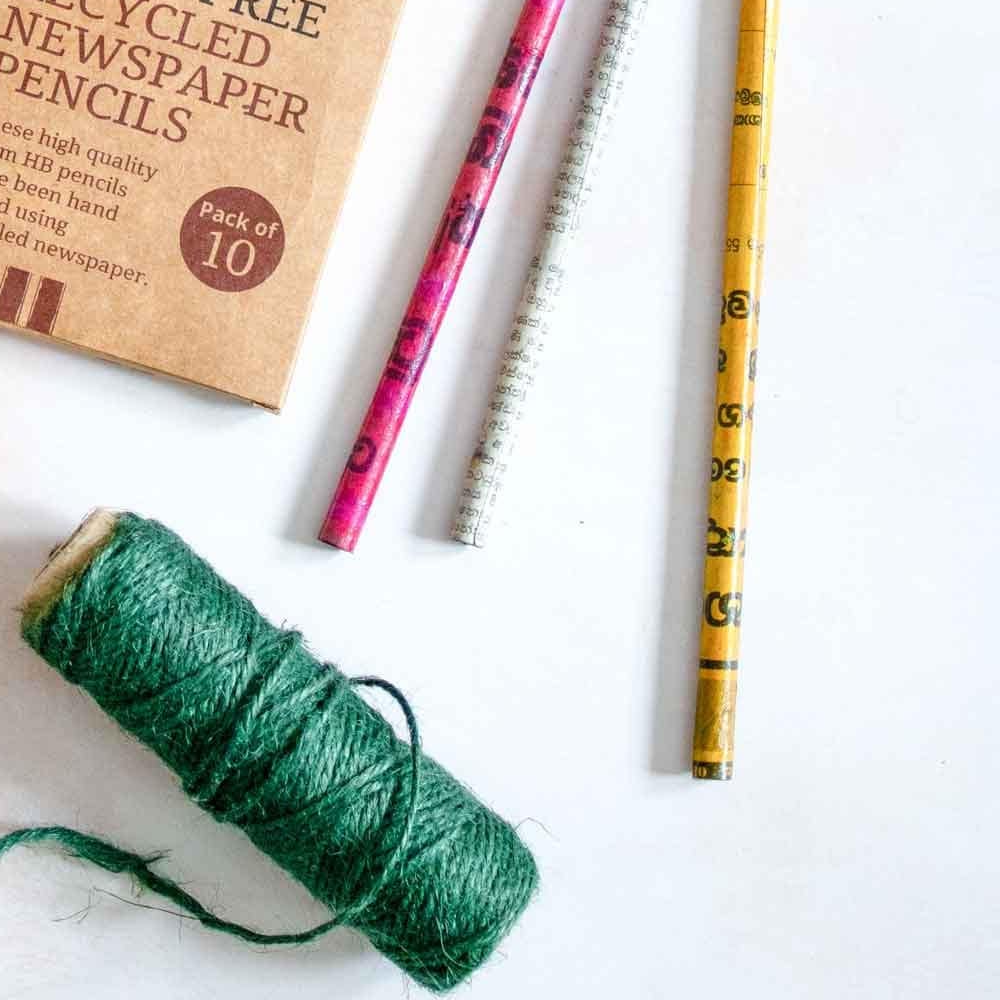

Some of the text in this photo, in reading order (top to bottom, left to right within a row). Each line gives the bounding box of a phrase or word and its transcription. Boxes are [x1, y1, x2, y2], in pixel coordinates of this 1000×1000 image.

[0, 5, 309, 134] NEWSPAPER
[22, 151, 55, 174] HB
[57, 164, 128, 198] pencils
[37, 128, 81, 156] high
[86, 146, 159, 183] quality
[13, 174, 62, 206] been
[67, 190, 120, 222] hand
[15, 205, 70, 236] using
[199, 201, 281, 240] Pack of
[33, 237, 150, 287] newspaper.
[202, 231, 257, 277] 10
